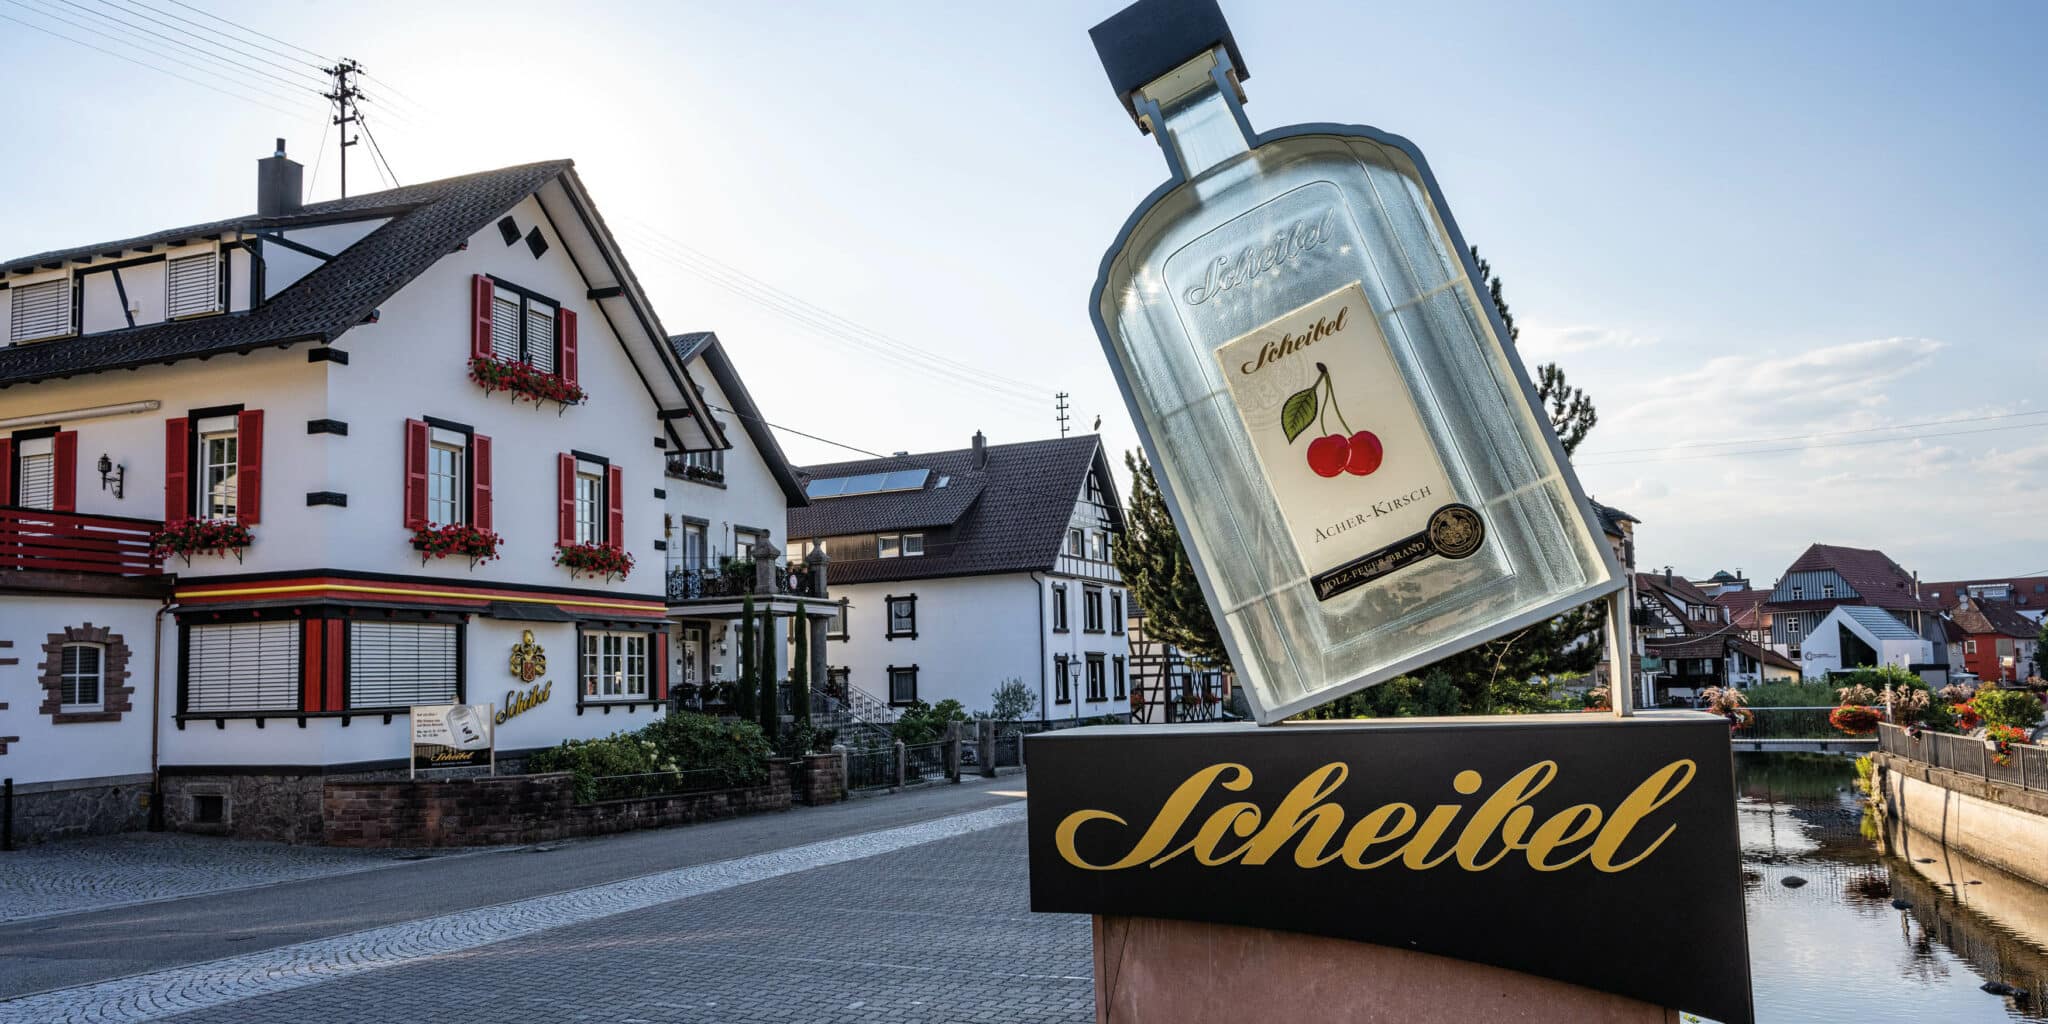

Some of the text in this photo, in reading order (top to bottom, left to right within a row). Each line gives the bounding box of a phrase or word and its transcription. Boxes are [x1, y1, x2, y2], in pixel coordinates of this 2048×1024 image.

[1184, 208, 1335, 306] Scheibel
[1241, 306, 1348, 374] Scheibel
[1314, 485, 1432, 543] ACHER-KIRSCH
[496, 679, 552, 725] Scheibel
[1056, 759, 1696, 872] Scheibel
